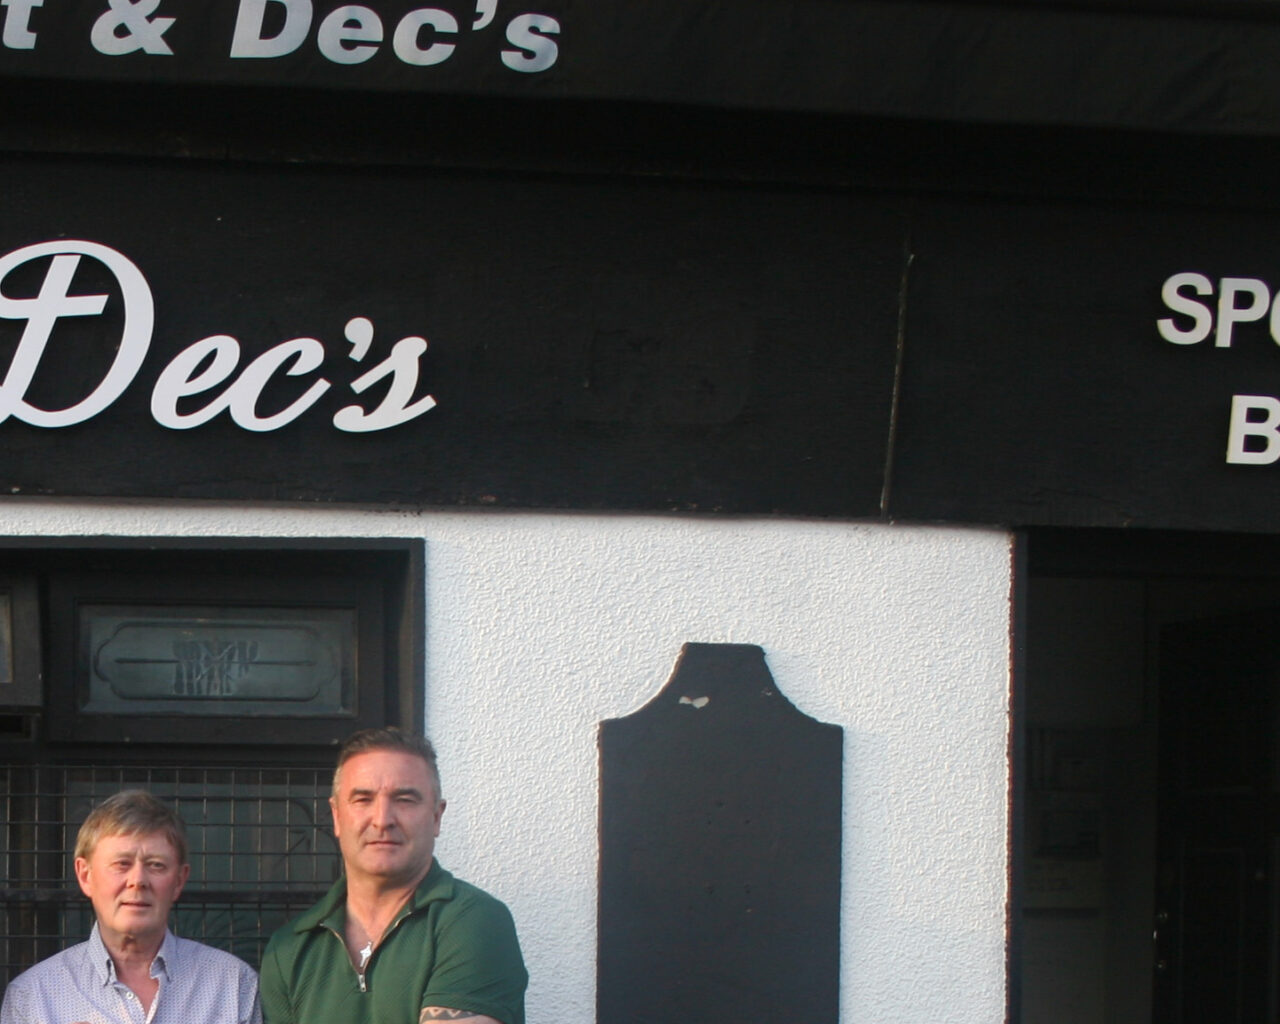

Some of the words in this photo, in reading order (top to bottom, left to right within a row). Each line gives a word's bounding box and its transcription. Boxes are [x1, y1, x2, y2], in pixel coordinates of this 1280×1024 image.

[90, 0, 176, 56] &
[229, 0, 560, 72] Dec's
[1157, 272, 1280, 348] SP
